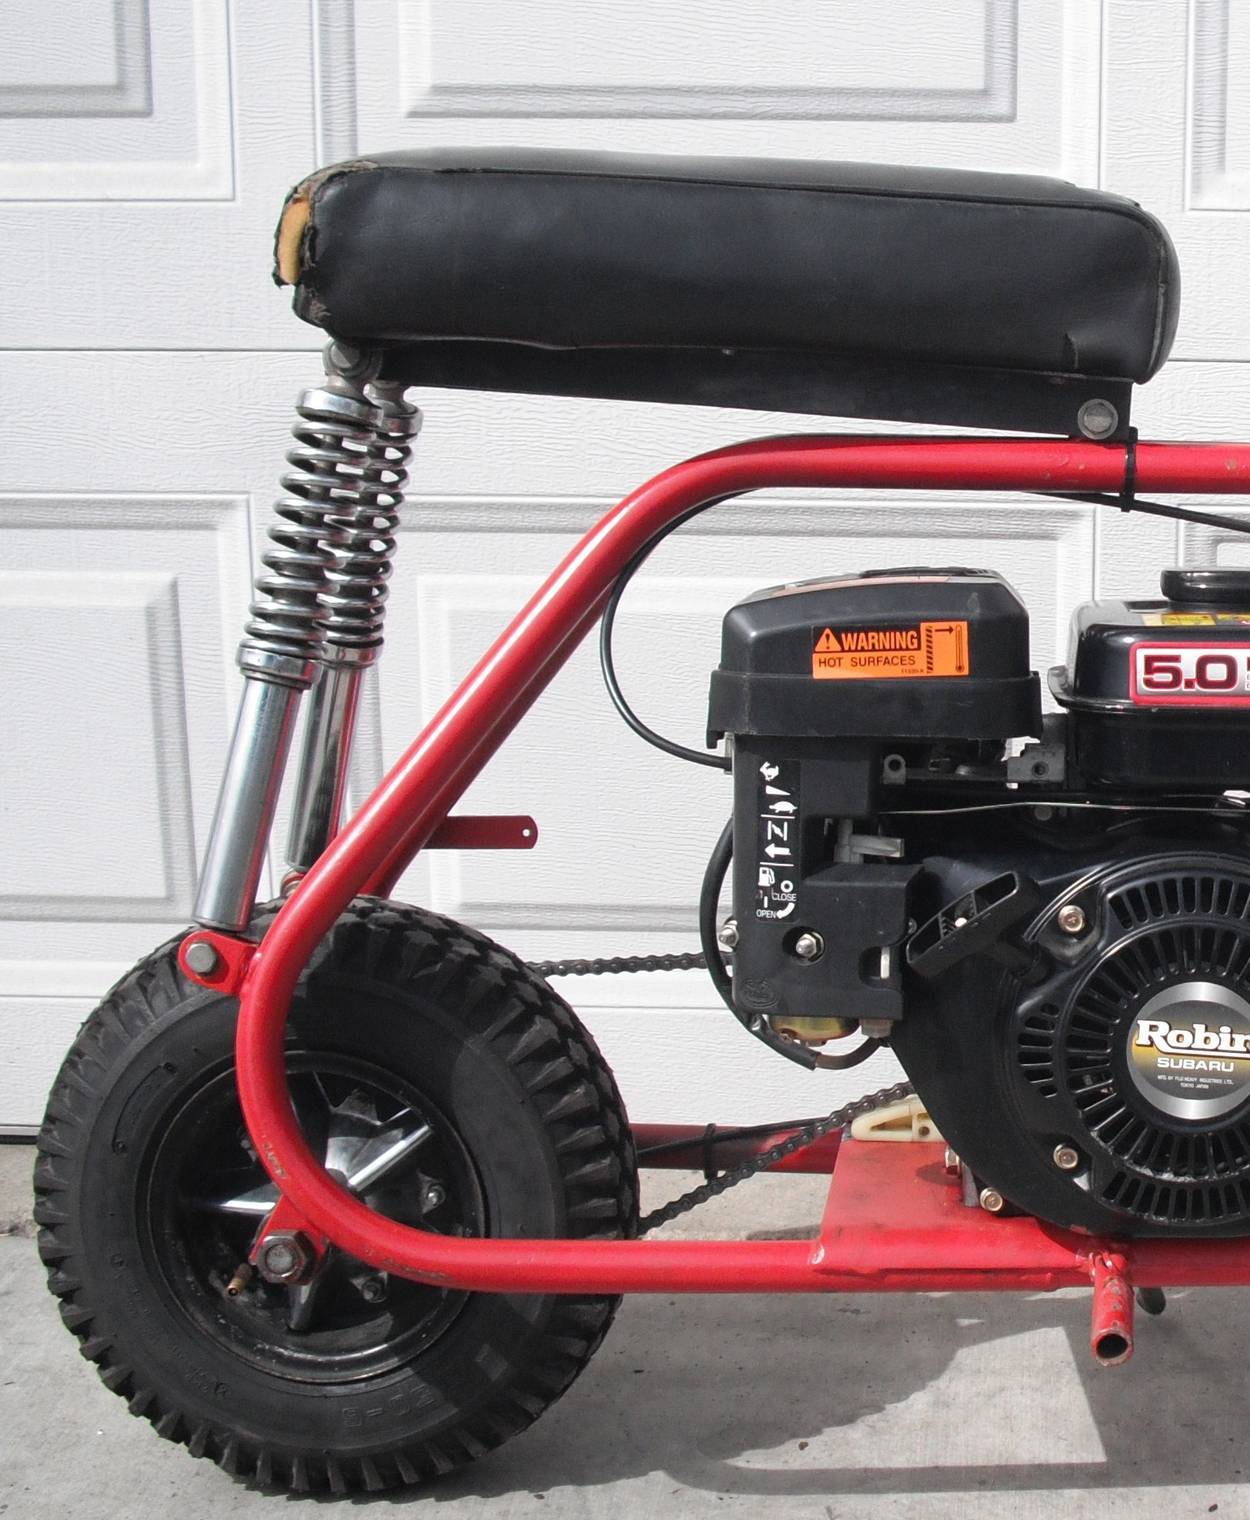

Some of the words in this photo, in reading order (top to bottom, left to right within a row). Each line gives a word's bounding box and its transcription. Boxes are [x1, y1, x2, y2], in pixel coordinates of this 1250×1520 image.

[841, 631, 918, 650] WARNING
[818, 657, 843, 668] HOT
[850, 655, 916, 667] SURFACES
[1143, 654, 1238, 691] 5.0
[772, 892, 797, 902] CLOSE
[756, 909, 777, 919] OPEN
[1157, 1057, 1235, 1073] SUBARU
